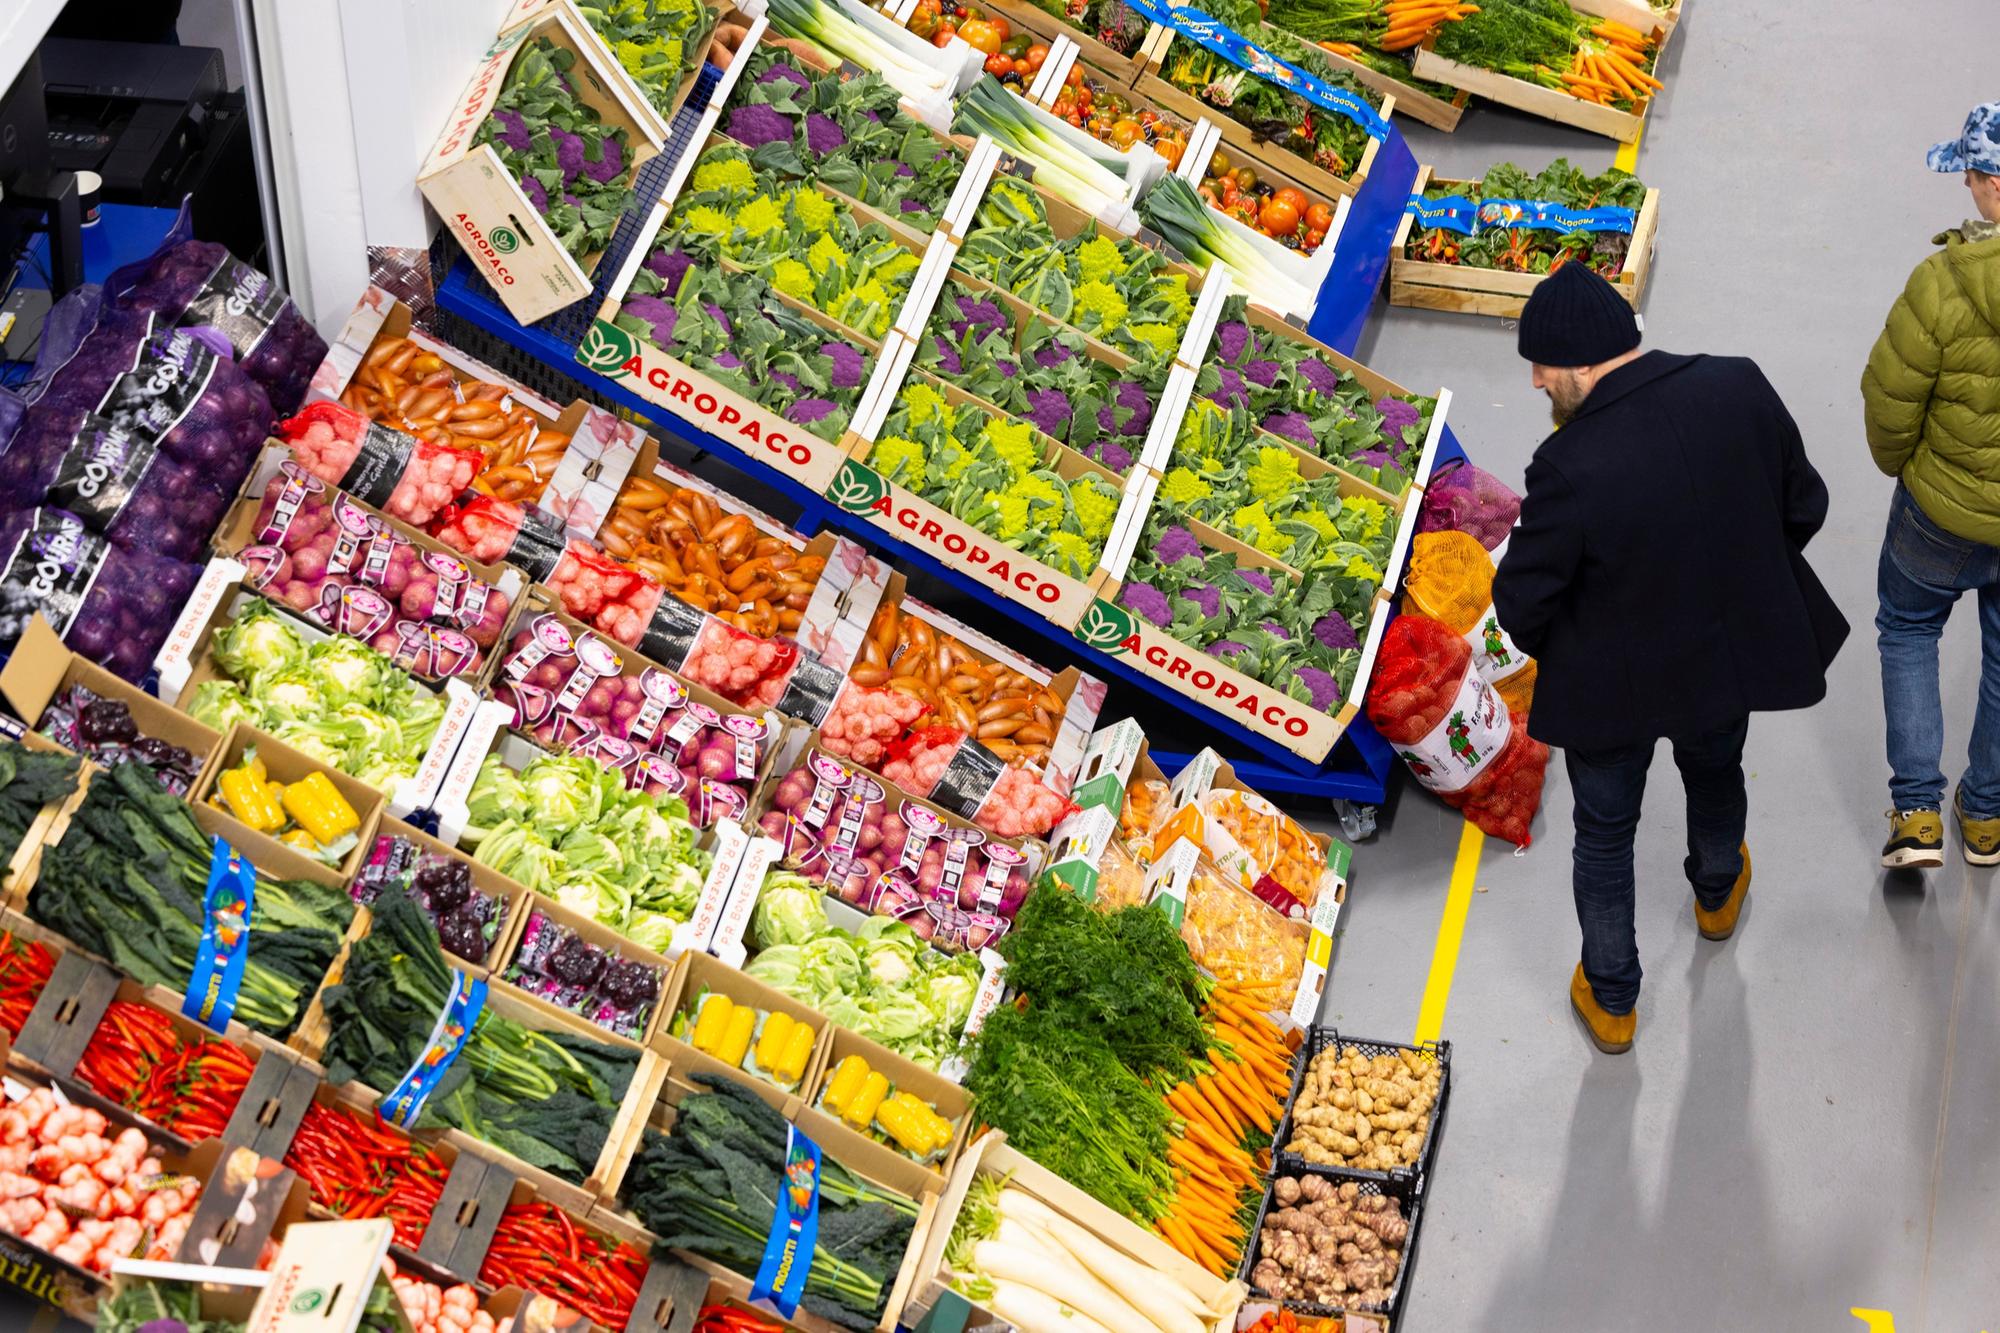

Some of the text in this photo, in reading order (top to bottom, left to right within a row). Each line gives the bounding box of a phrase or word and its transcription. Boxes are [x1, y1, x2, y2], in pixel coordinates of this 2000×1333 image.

[440, 50, 508, 157] AGROPACO
[456, 212, 515, 286] AGROPACO
[1554, 213, 1595, 227] PRODOTTI
[226, 269, 267, 316] GOURM
[146, 329, 193, 396] GOURM
[620, 355, 811, 465] AGROPACO
[871, 495, 1060, 602] AGROPACO
[1119, 634, 1309, 736] AGROPACO
[0, 1257, 71, 1307] arlic
[772, 1238, 797, 1293] PRODOTTI
